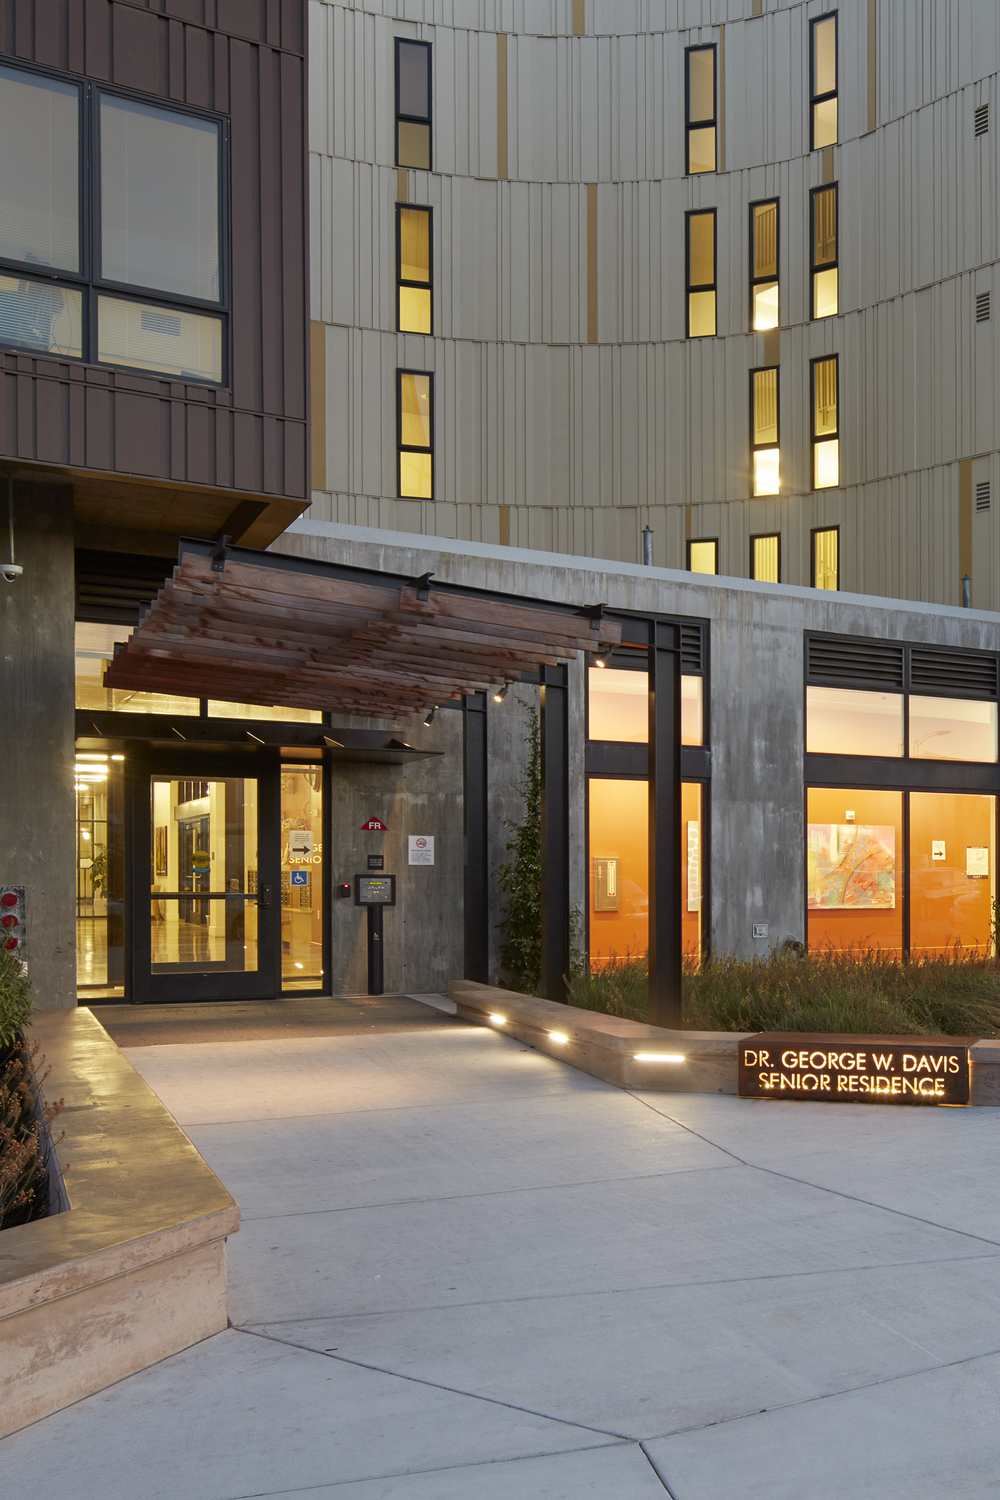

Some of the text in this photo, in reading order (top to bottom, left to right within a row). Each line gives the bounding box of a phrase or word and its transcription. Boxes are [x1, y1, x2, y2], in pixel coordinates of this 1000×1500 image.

[744, 1050, 960, 1074] DR. GEORGE W. DAVIS
[758, 1072, 945, 1096] SENIOR RESIDENCE
